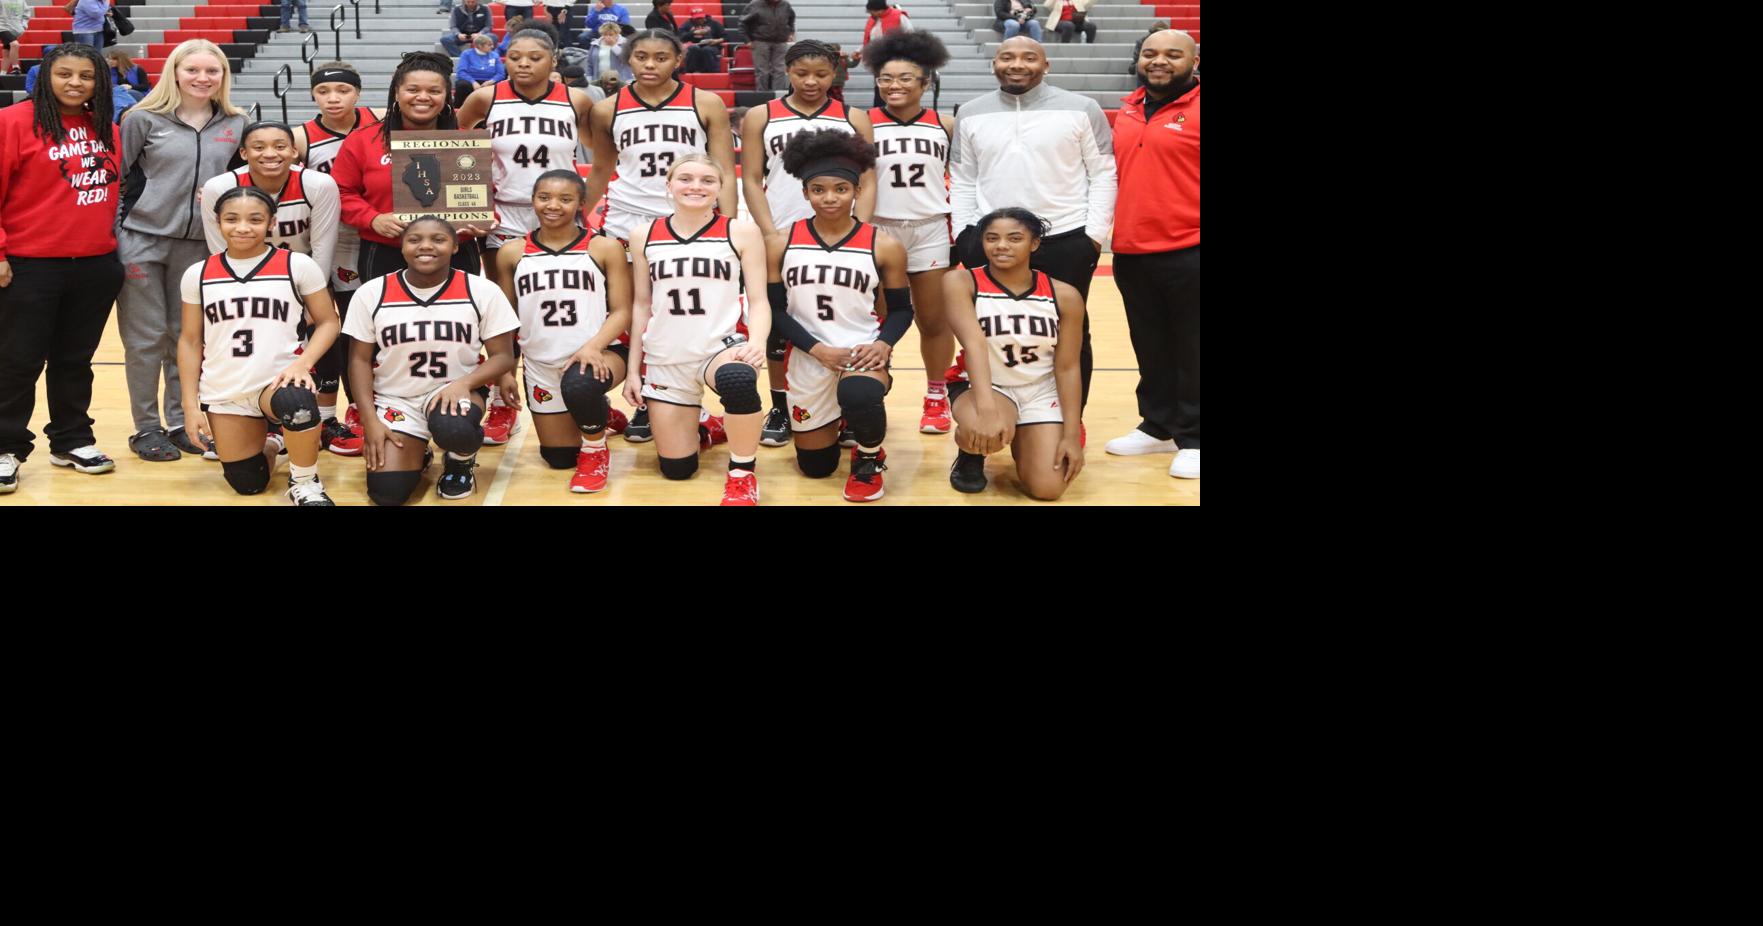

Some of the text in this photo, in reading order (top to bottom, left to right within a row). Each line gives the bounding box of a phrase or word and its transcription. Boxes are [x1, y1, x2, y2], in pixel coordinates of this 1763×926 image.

[69, 127, 87, 141] ON
[492, 116, 573, 140] ALTON
[620, 124, 696, 150] ALTON
[48, 140, 109, 160] GAME DA
[403, 140, 480, 148] REGIONAL
[513, 144, 549, 168] 44
[81, 157, 96, 168] WE
[640, 152, 674, 177] 33
[71, 169, 107, 188] WEAR
[452, 173, 480, 181] 2023
[890, 164, 925, 187] 12
[76, 187, 108, 206] RED!
[518, 269, 595, 297] ALTON
[786, 264, 870, 294] ALTON
[205, 296, 289, 325] ALTON
[540, 300, 578, 326] 23
[667, 288, 706, 315] 11
[816, 294, 834, 321] 5
[232, 329, 253, 358] 3
[381, 320, 472, 348] ALTON
[409, 351, 447, 378] 25
[1001, 344, 1039, 368] 15
